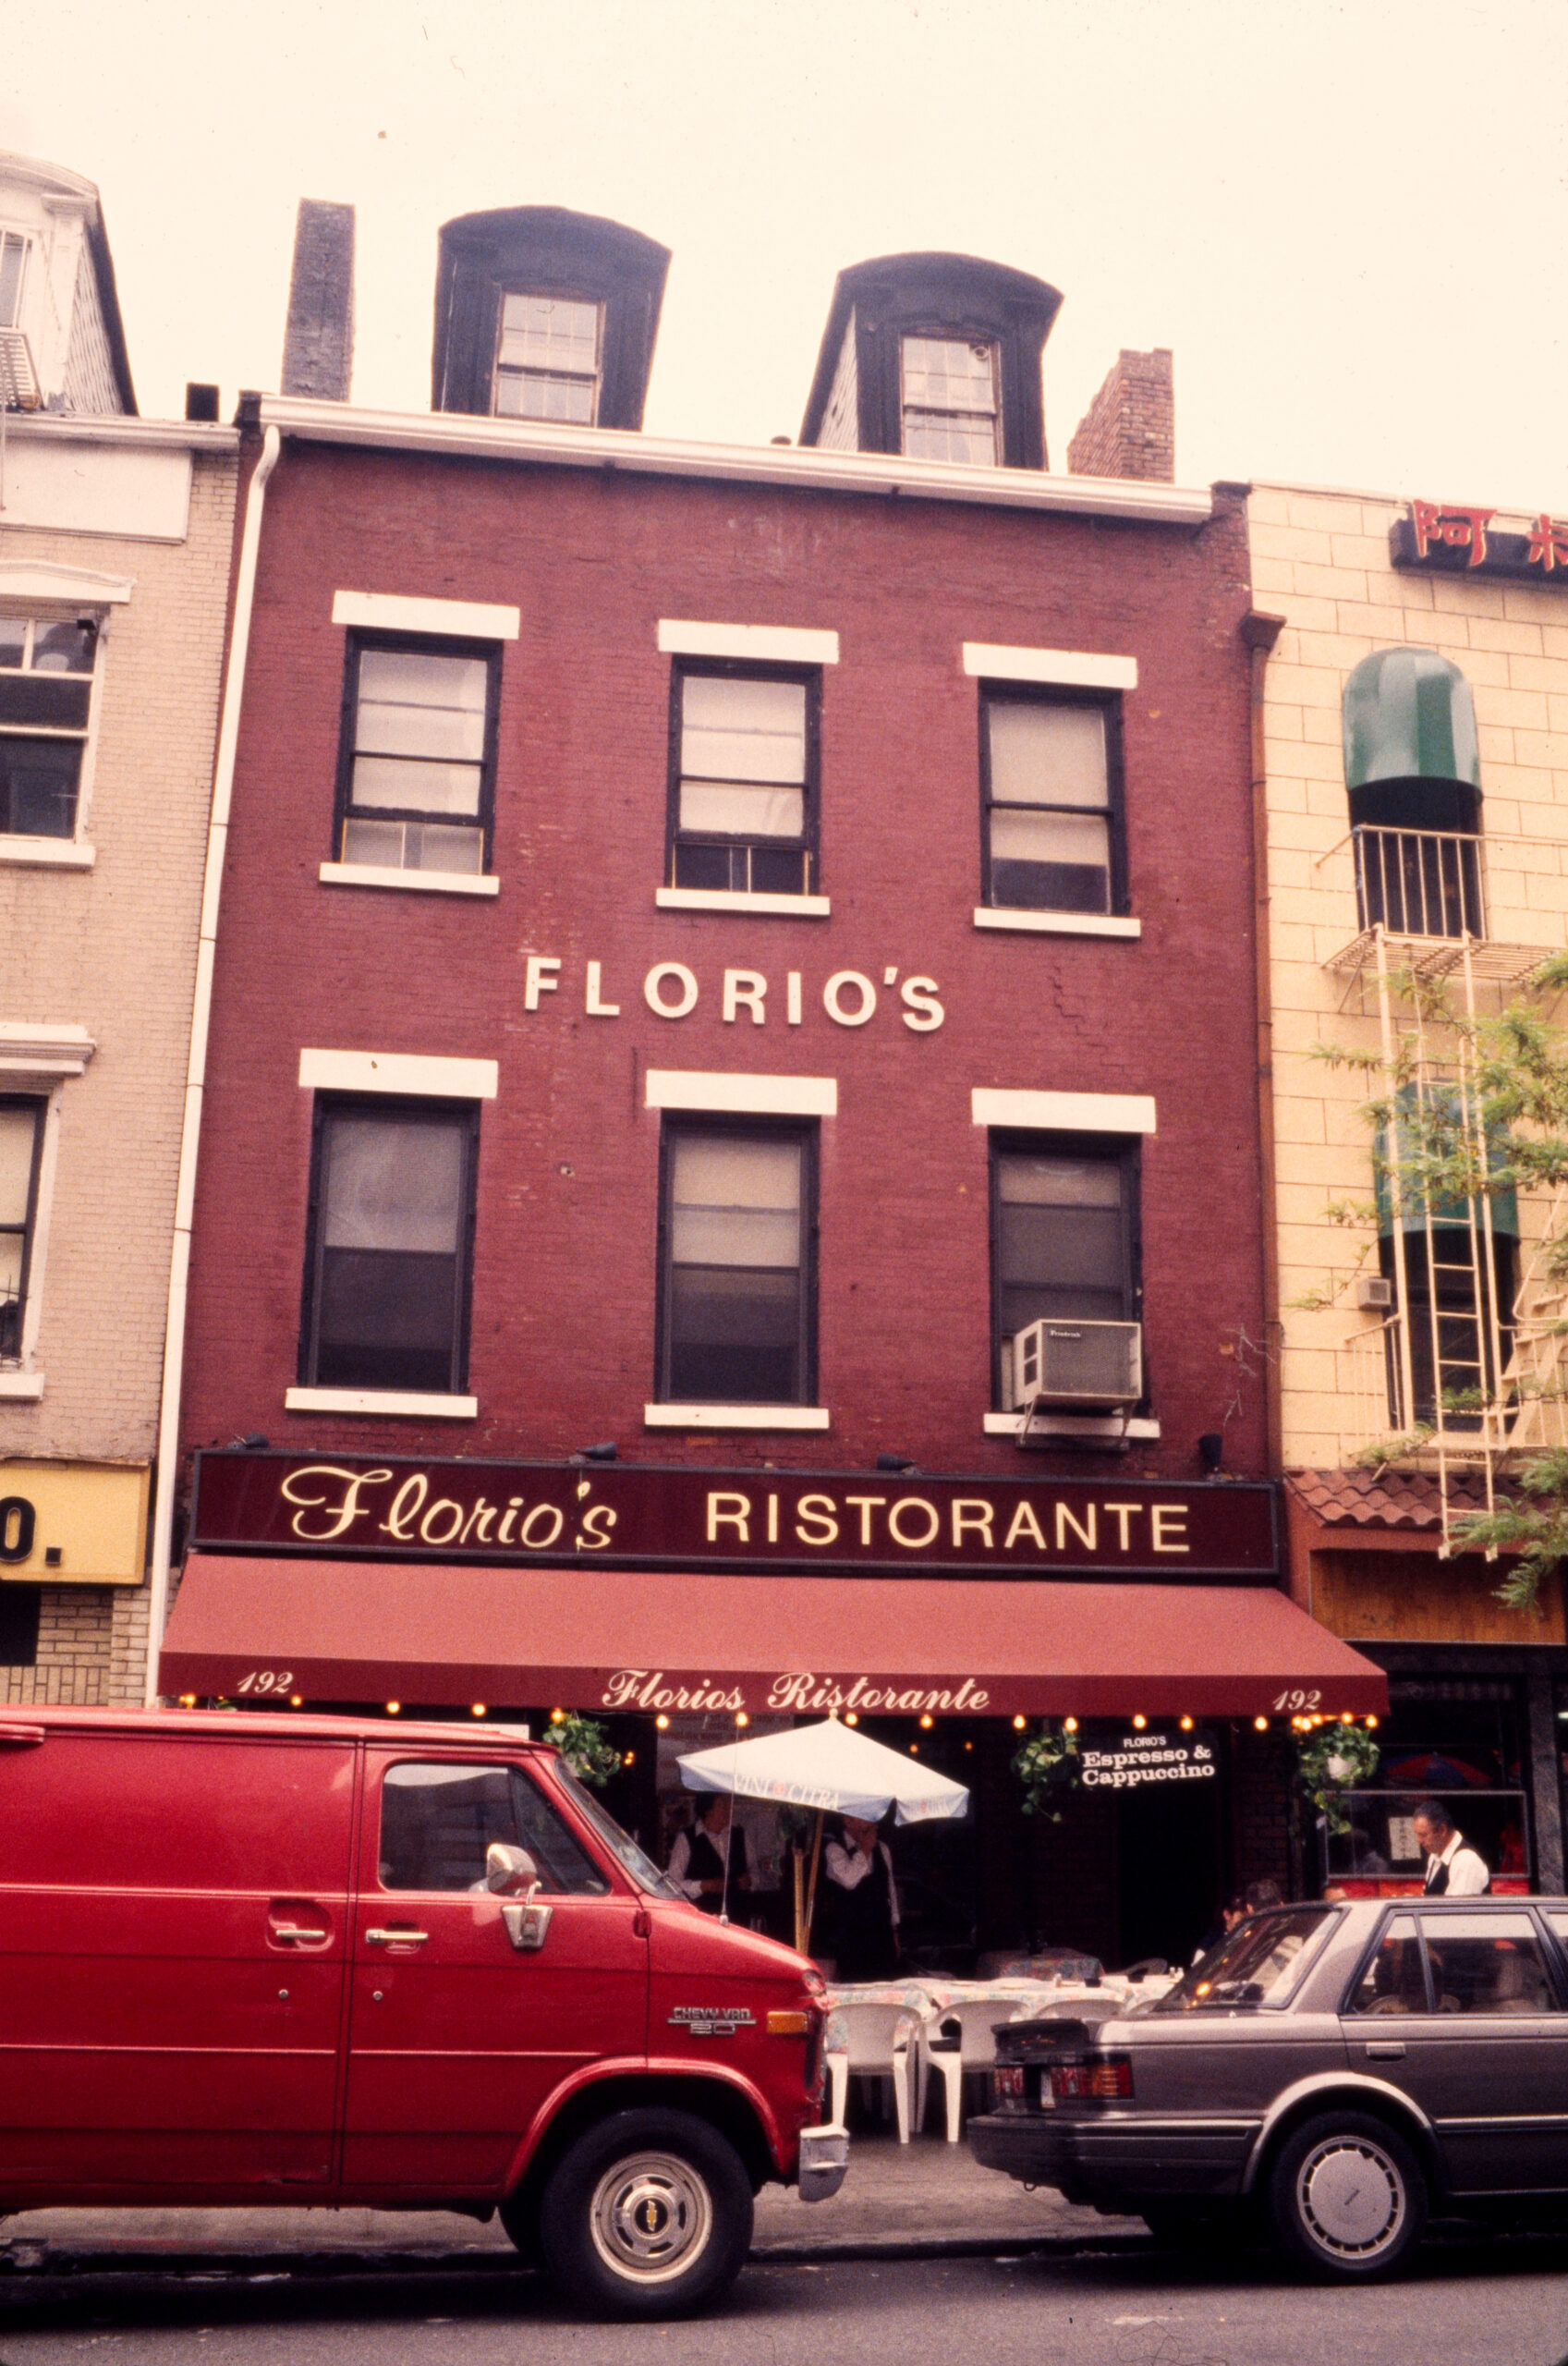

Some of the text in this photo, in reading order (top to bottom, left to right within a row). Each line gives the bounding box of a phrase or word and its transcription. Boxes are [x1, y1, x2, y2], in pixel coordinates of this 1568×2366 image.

[525, 956, 945, 1031] FLORIO'S
[281, 1466, 1191, 1553] Florio's RISTORANTE
[236, 1671, 294, 1694] 192
[602, 1669, 991, 1711] Florios Ristorante
[1272, 1689, 1322, 1711] 192
[1123, 1736, 1167, 1749] FLORIO'S
[1082, 1744, 1212, 1770] Espresso &
[1082, 1762, 1216, 1787] Cappuccino
[673, 2006, 751, 2020] CHEVY VAN
